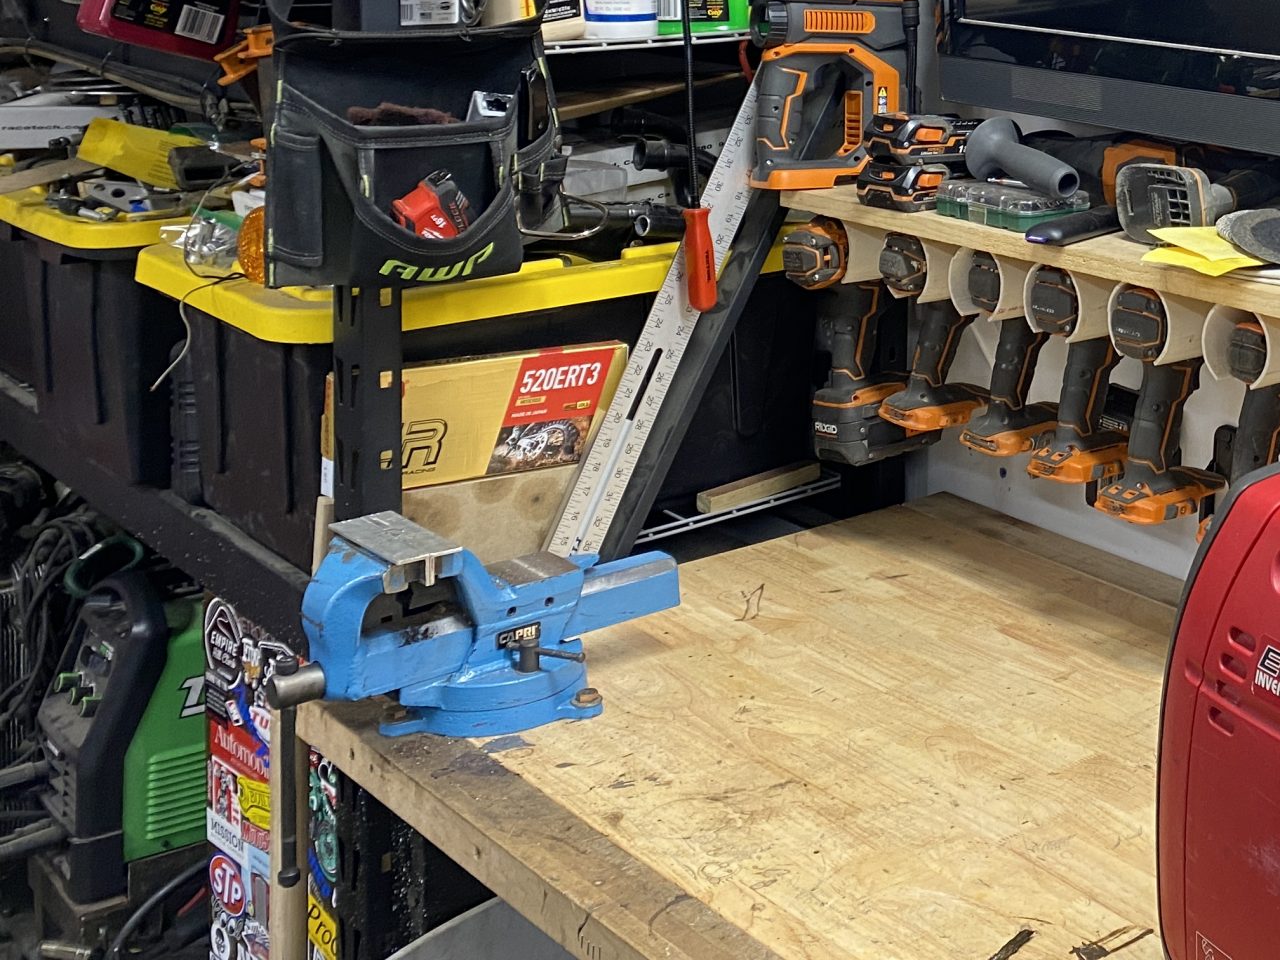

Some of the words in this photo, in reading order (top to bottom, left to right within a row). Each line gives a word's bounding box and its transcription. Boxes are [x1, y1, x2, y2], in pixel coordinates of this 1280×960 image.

[519, 362, 602, 394] 520ERT3
[815, 422, 838, 435] RIDGID
[211, 630, 238, 657] EMPIRE
[499, 625, 538, 644] CAPRI
[210, 818, 245, 852] MISSION
[213, 862, 242, 905] STP
